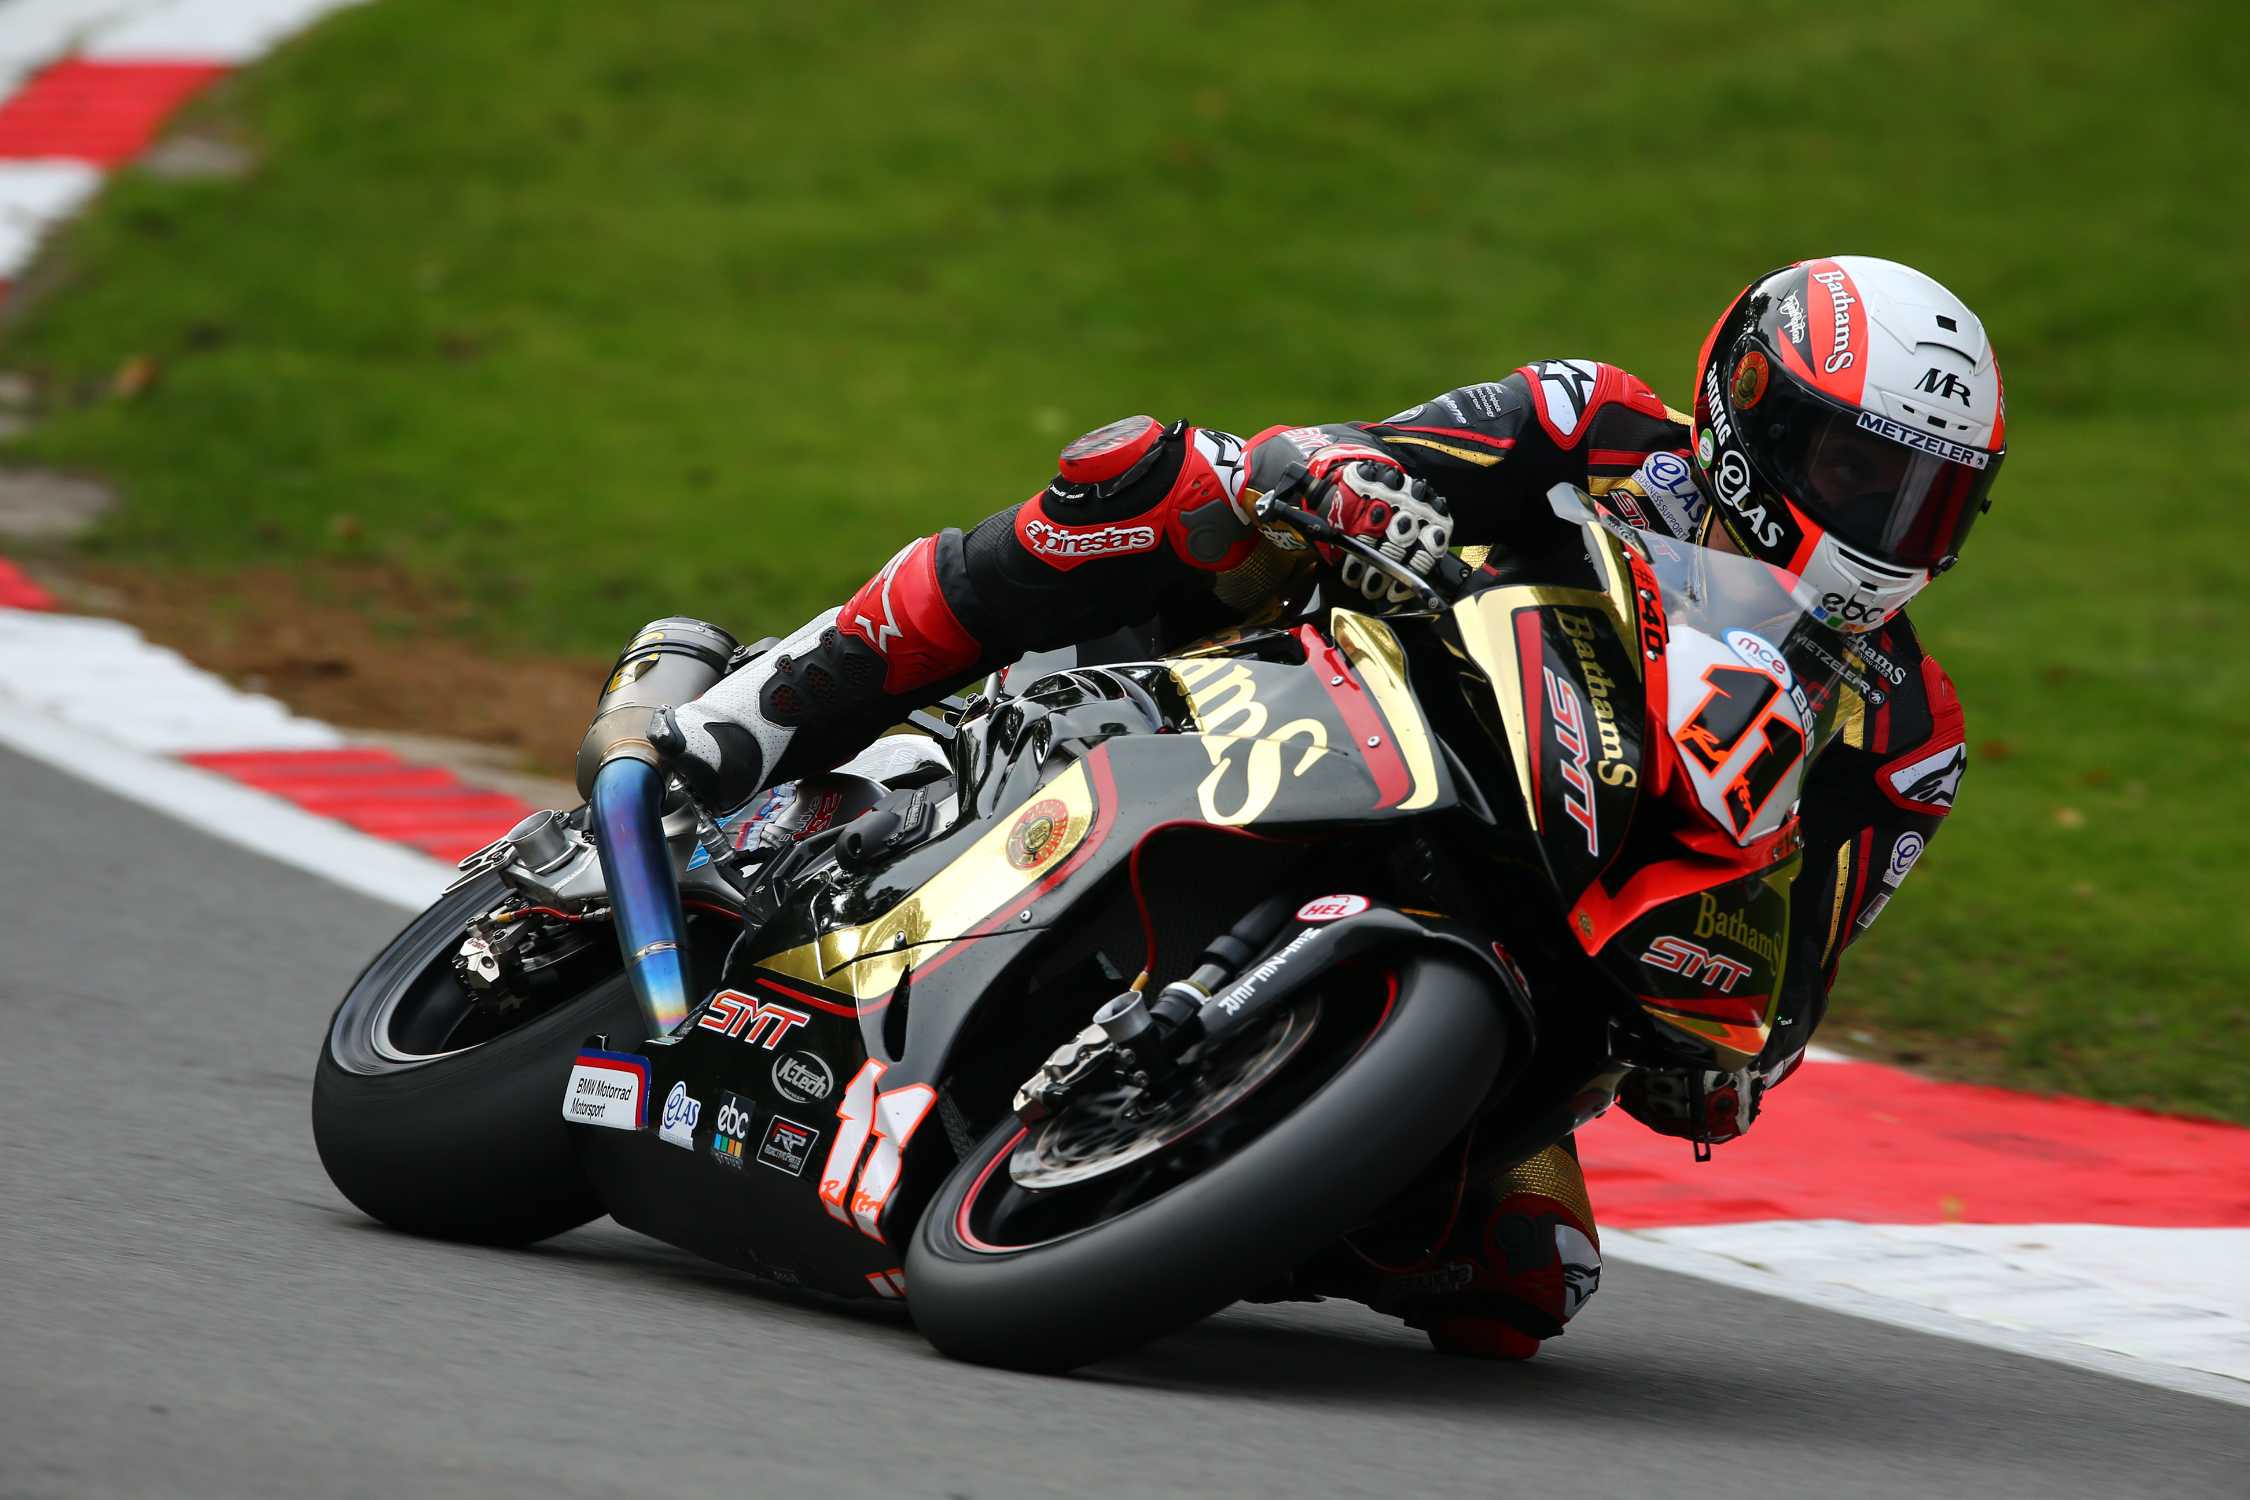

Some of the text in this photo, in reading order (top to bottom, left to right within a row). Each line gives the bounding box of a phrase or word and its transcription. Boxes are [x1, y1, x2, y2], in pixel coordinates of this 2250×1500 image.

[1914, 367, 1972, 408] MR
[1860, 412, 1975, 464] METZELER
[1632, 471, 1688, 539] BUSINESS SUPPORT
[1024, 519, 1155, 557] alpinestars
[1821, 592, 1885, 624] ebc
[1738, 636, 1786, 676] mce
[1543, 665, 1599, 857] SMT
[1673, 663, 1805, 840] 11
[1303, 904, 1348, 916] HEL
[1218, 927, 1323, 1016] METZELER
[1640, 935, 1753, 993] SMT
[698, 988, 812, 1051] SMT
[570, 1097, 606, 1120] Motorsport
[576, 1078, 634, 1101] BMW Motorrad
[717, 1096, 749, 1140] ebc
